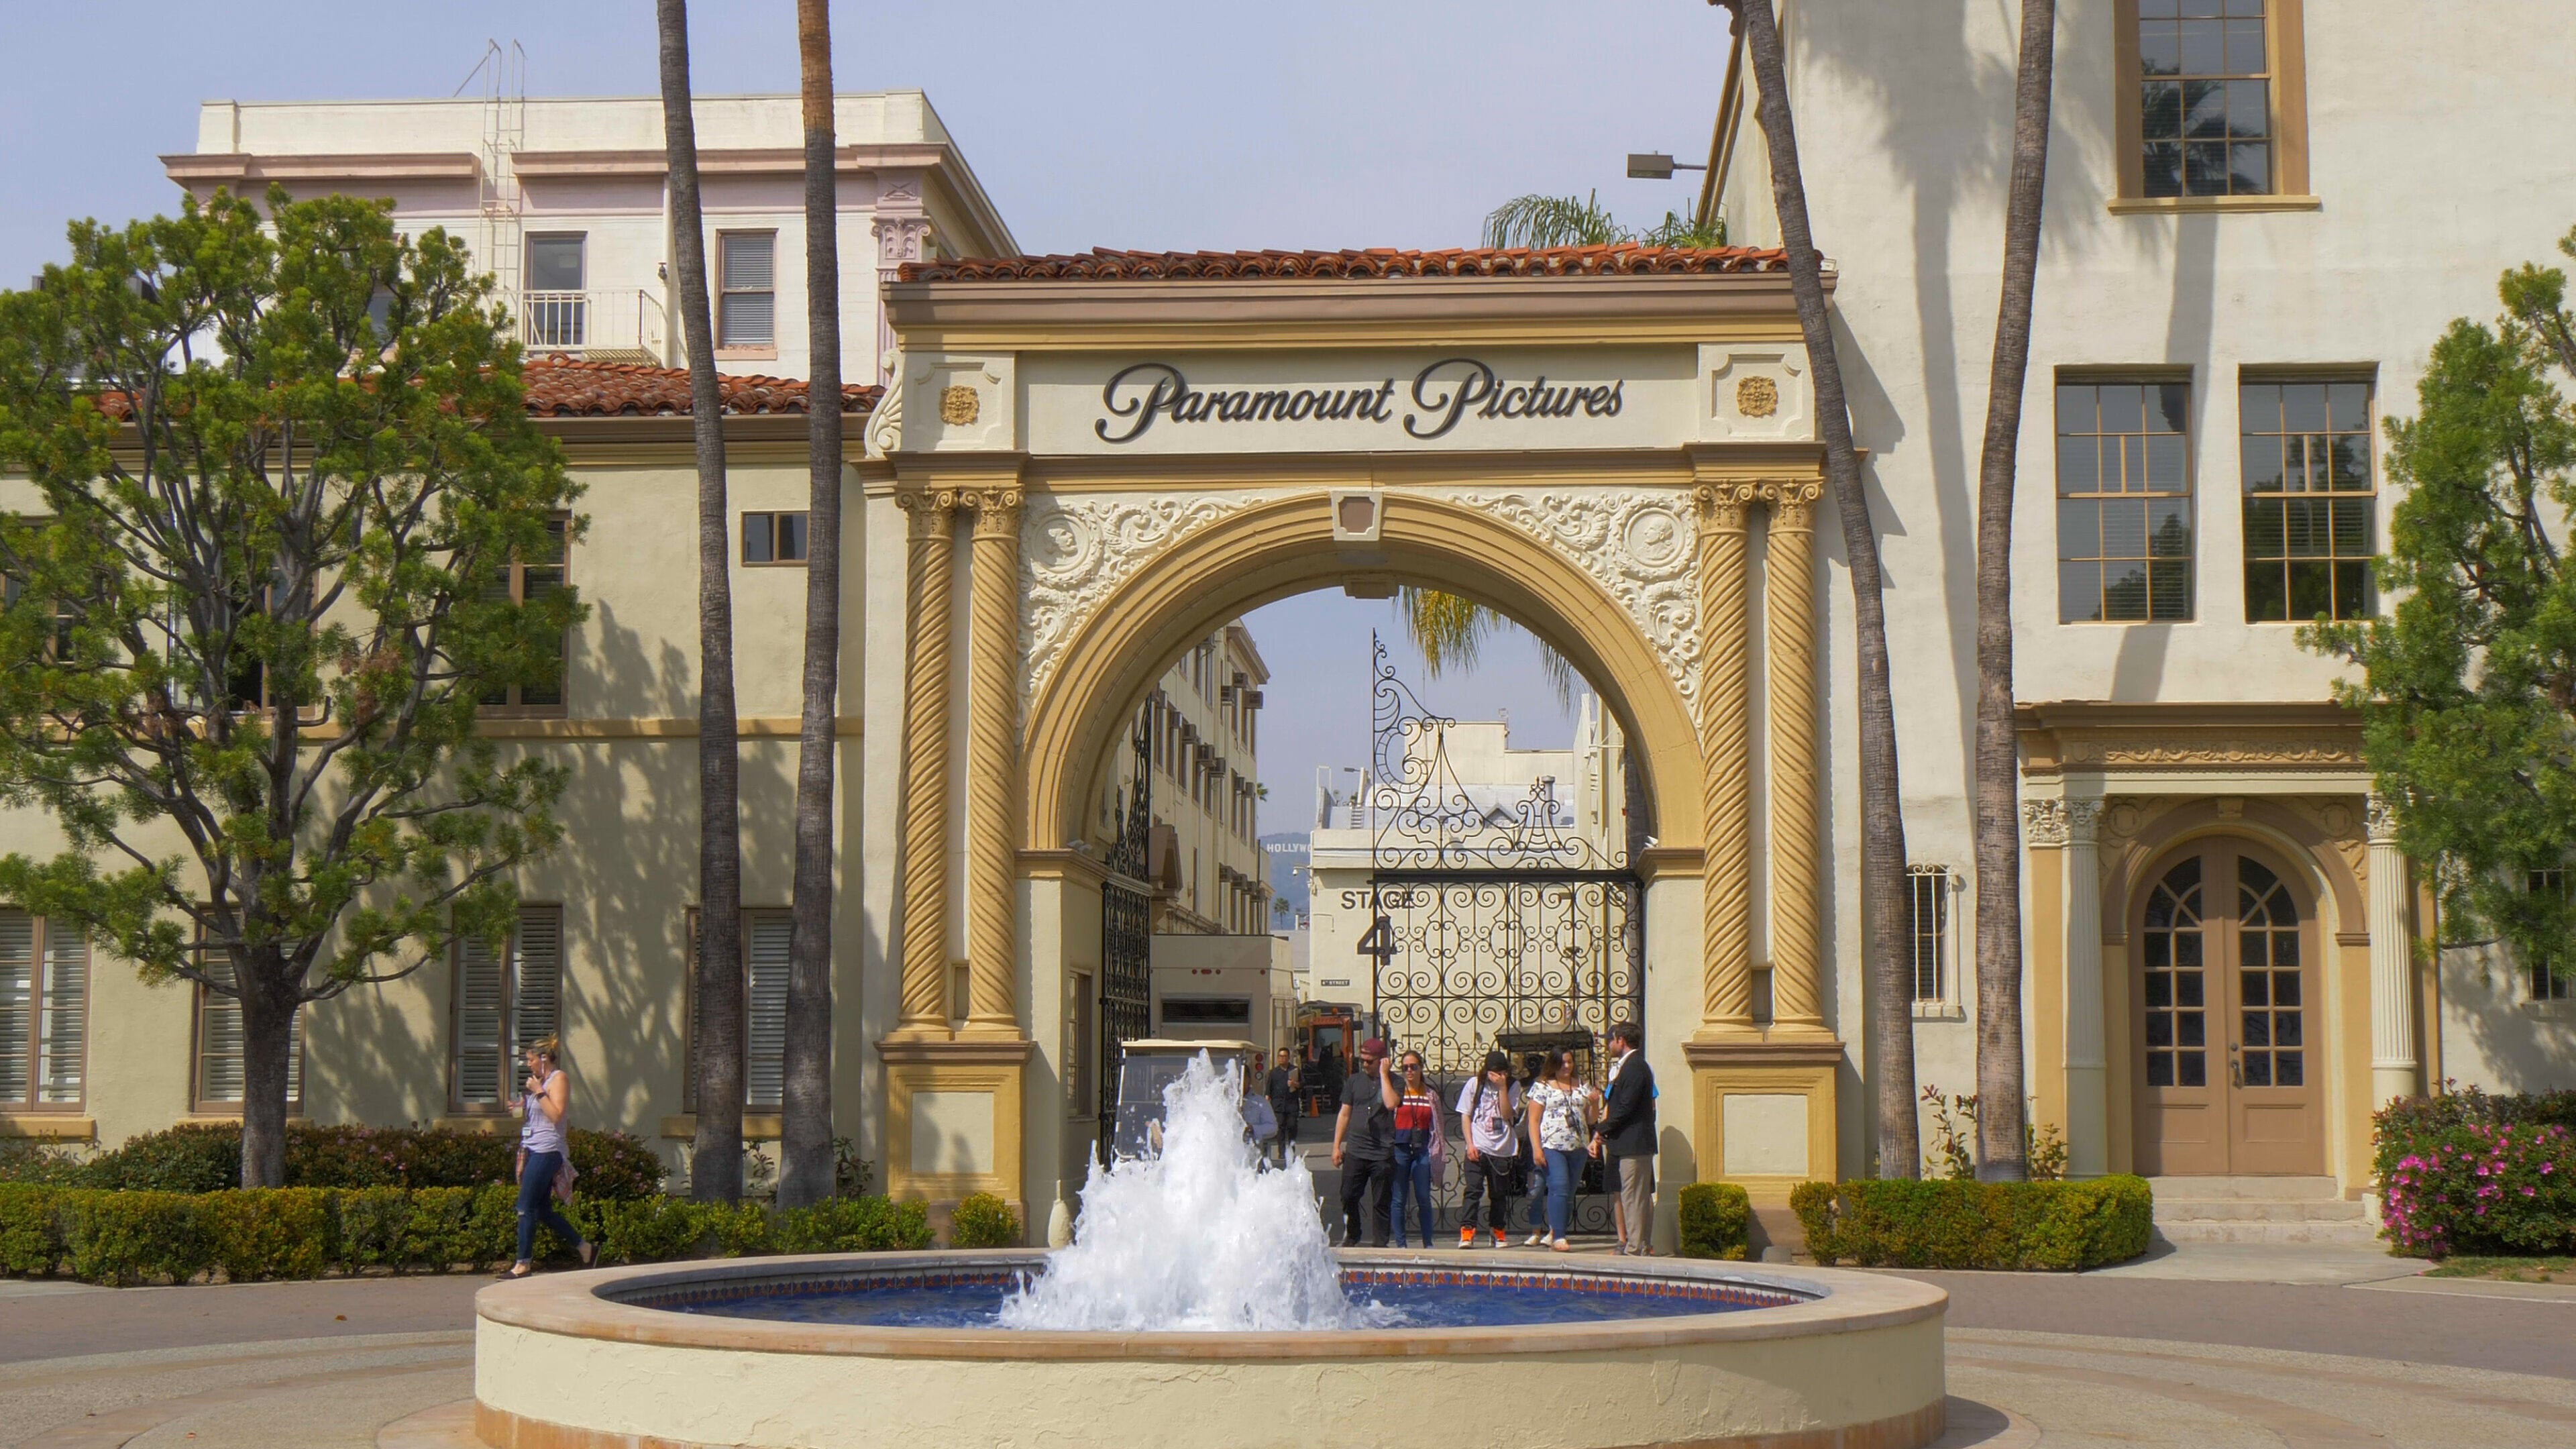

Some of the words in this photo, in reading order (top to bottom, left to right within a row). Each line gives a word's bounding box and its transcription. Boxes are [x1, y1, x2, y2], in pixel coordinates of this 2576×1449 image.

[1095, 362, 1394, 444] Paramount
[1403, 358, 1624, 440] Pictures
[1341, 891, 1415, 909] STAGE
[1357, 916, 1397, 965] 4
